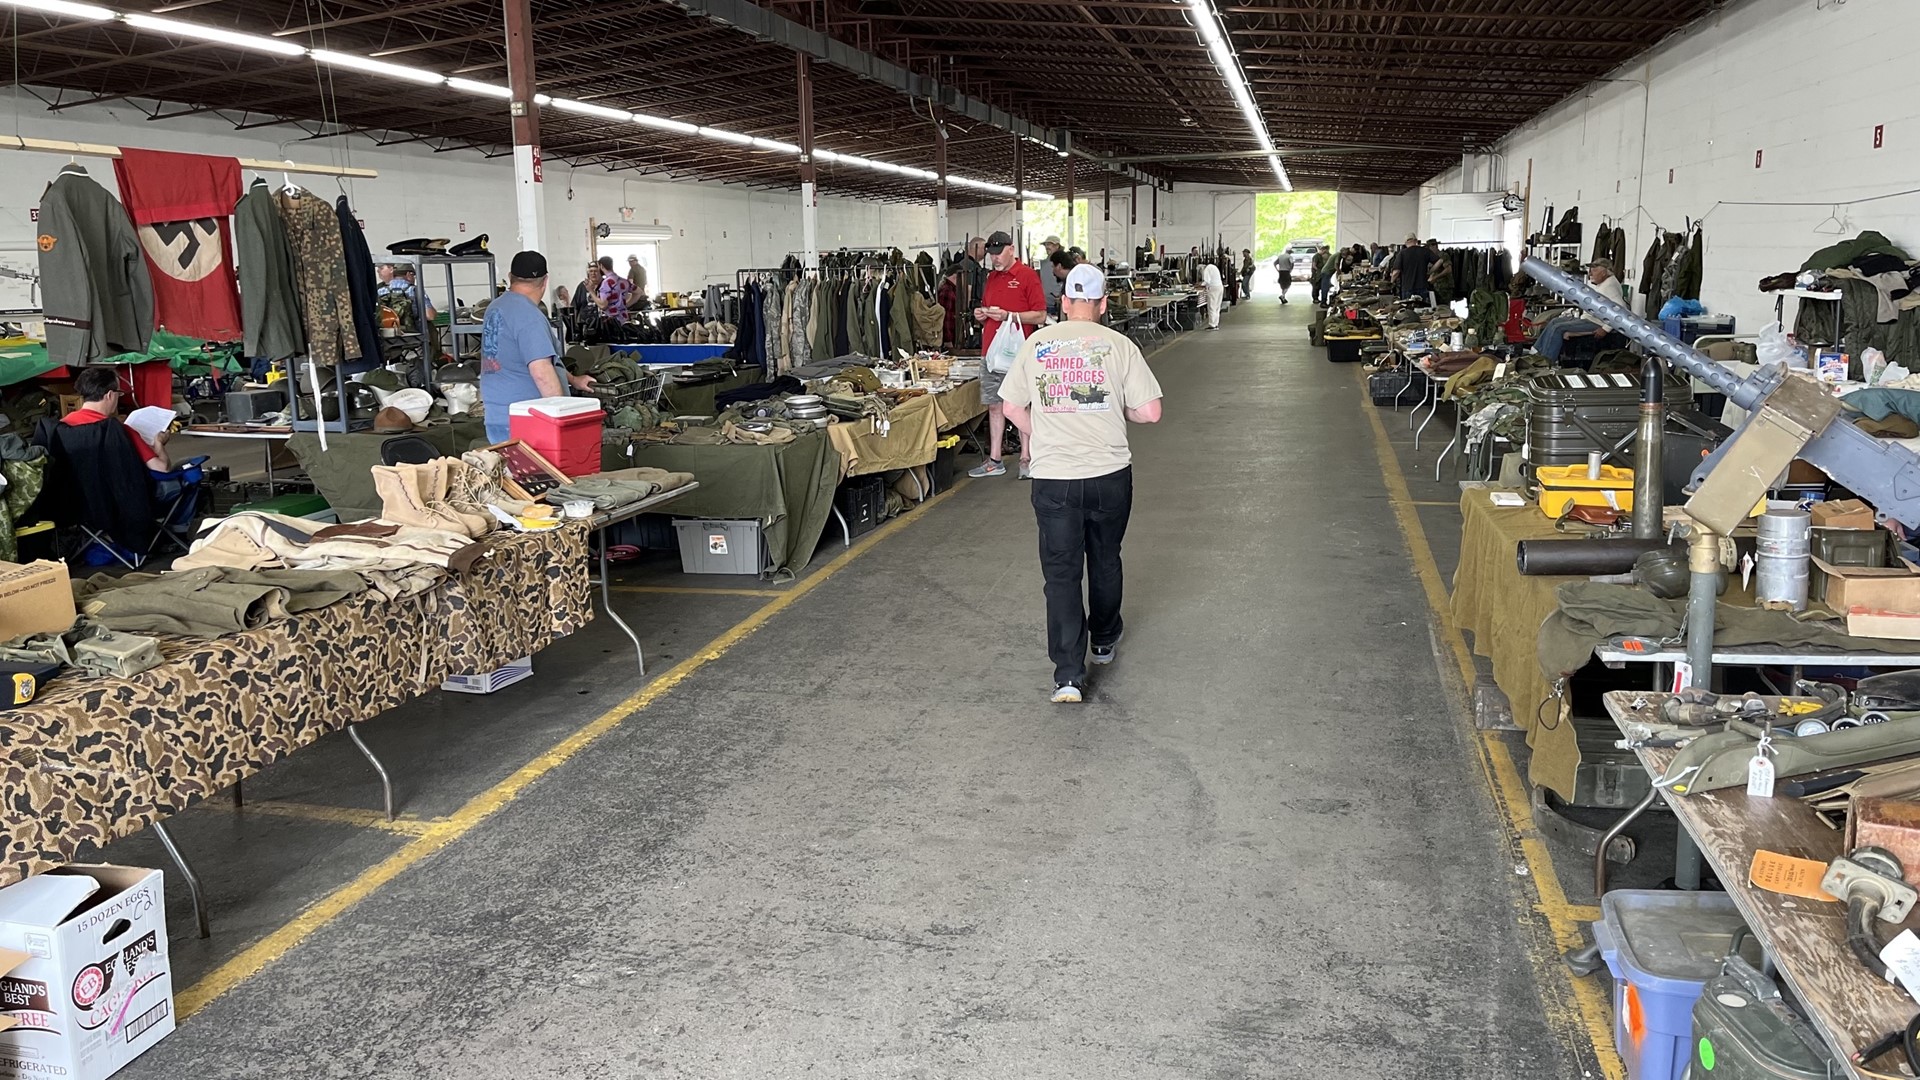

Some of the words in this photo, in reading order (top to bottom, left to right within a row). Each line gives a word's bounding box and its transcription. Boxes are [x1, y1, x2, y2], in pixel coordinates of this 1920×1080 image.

[1045, 357, 1084, 370] ARMED
[1062, 370, 1105, 384] FORCES
[1049, 384, 1071, 397] DAY
[77, 920, 88, 934] 15
[89, 903, 123, 927] DOZEN
[125, 886, 149, 907] EGGS
[80, 976, 98, 997] EB
[4, 992, 31, 1006] BEST
